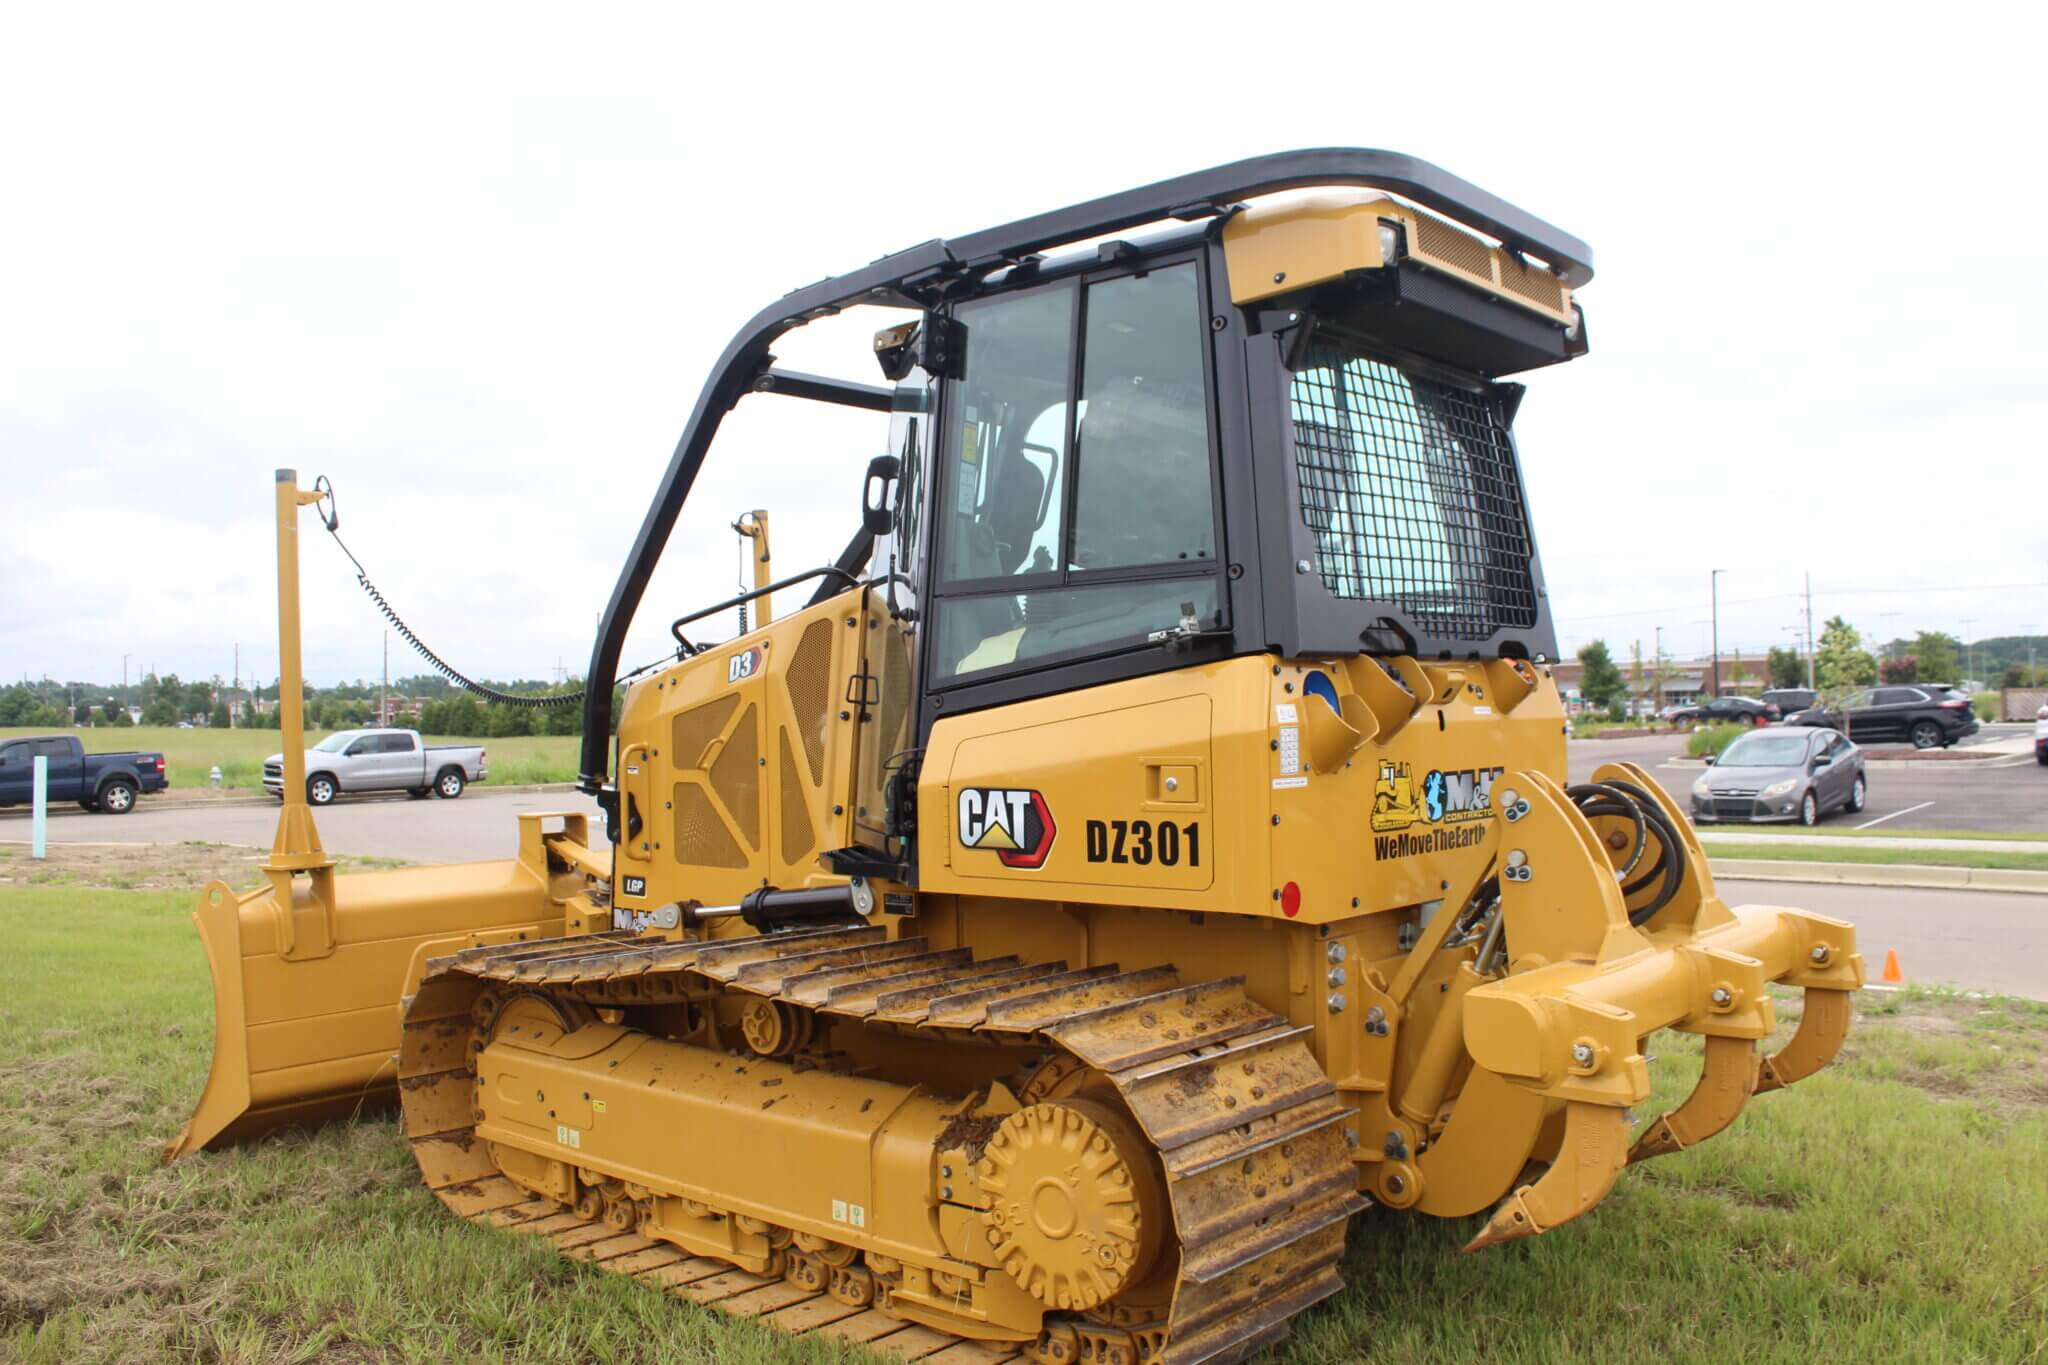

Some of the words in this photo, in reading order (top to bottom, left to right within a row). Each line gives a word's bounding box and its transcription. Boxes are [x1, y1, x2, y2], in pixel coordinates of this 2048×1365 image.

[729, 650, 752, 682] D3
[959, 788, 1031, 849] CAT
[1086, 819, 1199, 867] DZ301
[626, 879, 643, 893] LGP
